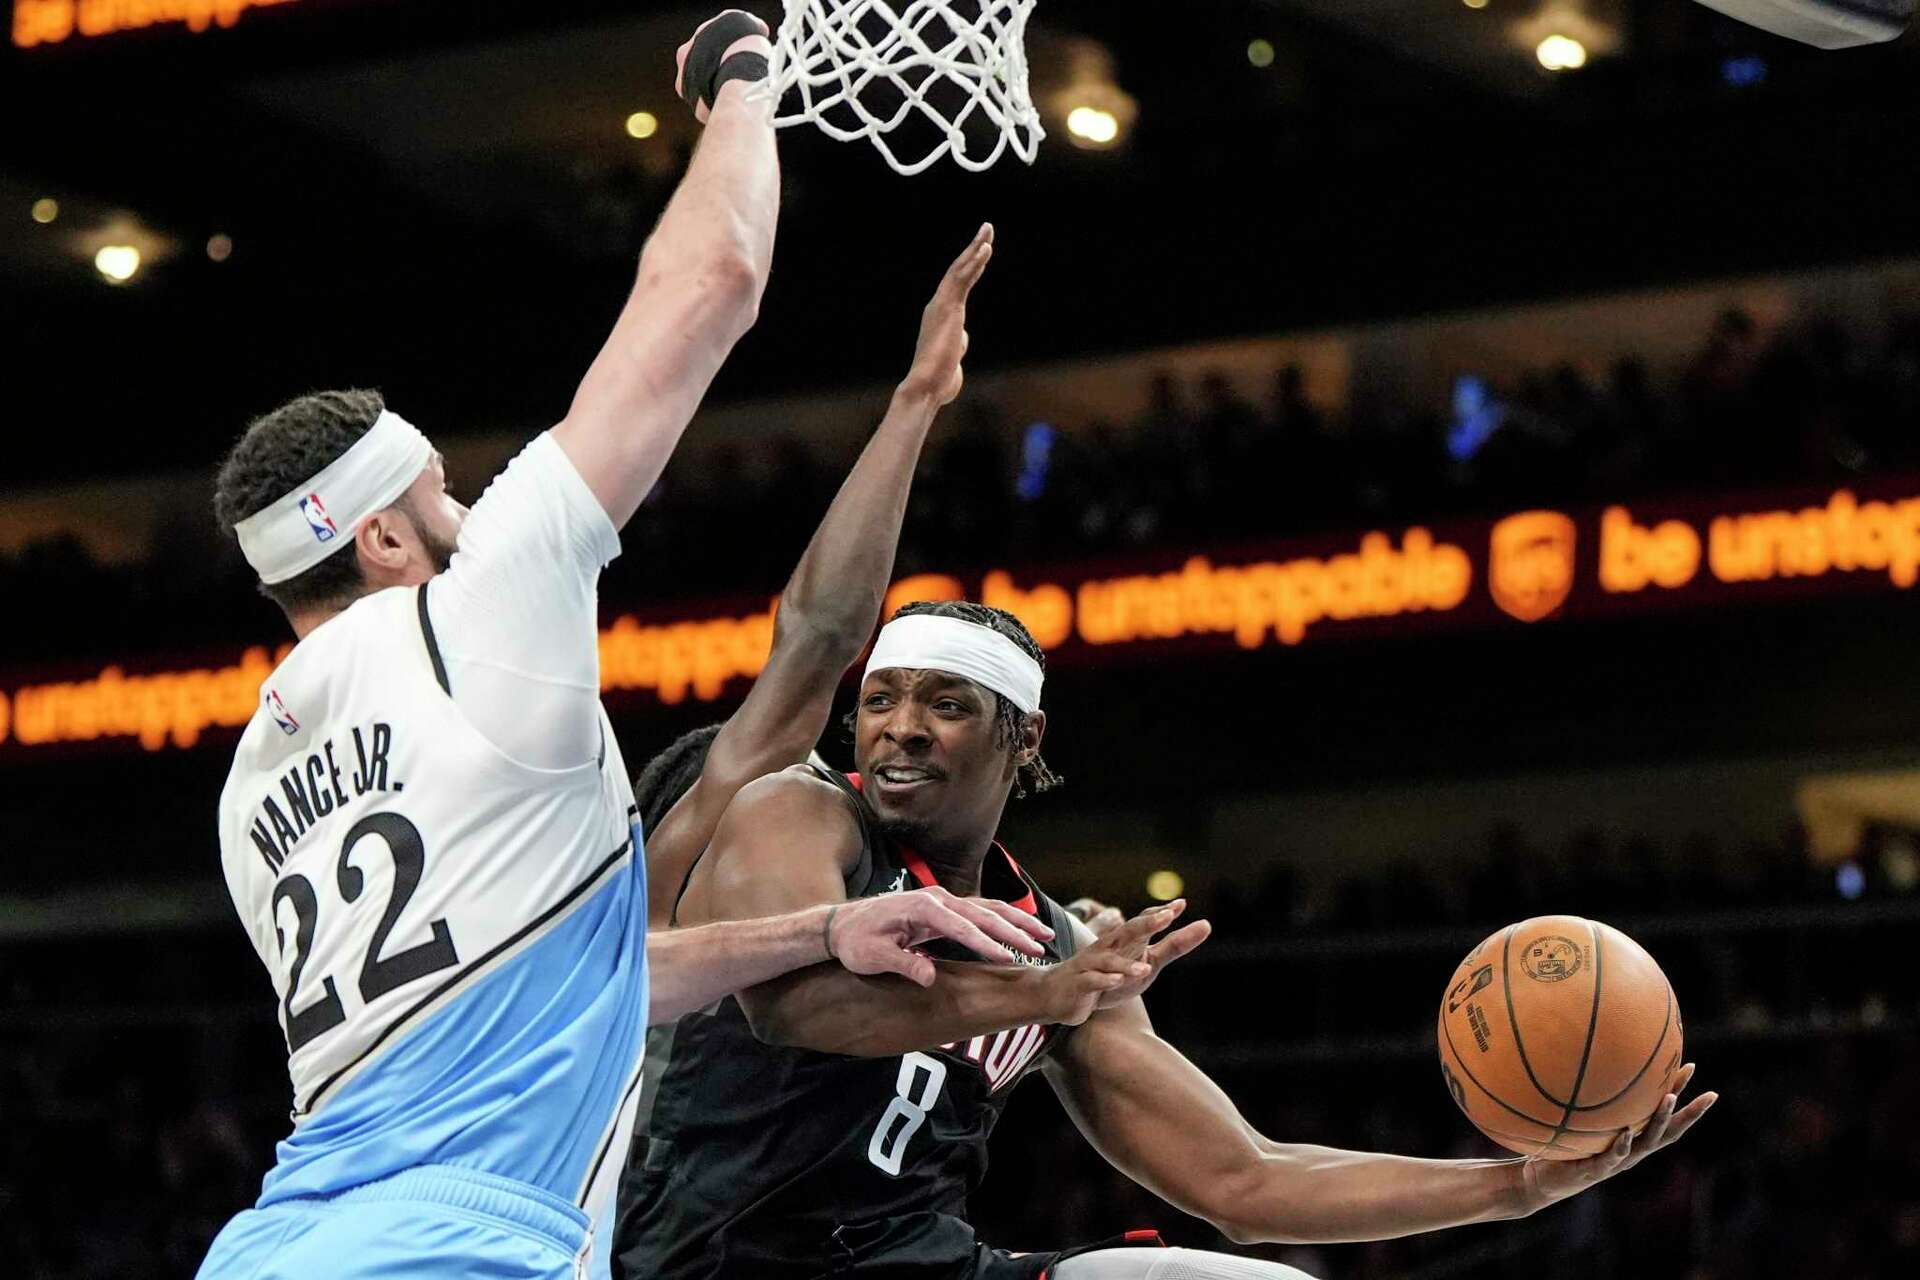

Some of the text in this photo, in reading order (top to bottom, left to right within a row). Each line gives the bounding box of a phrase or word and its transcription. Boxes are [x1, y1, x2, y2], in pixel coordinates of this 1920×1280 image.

[1077, 526, 1472, 650] unstoppable
[1599, 505, 1699, 593] be
[249, 722, 404, 878] NANCE JR.
[271, 811, 460, 1054] 22
[867, 1050, 947, 1177] 8
